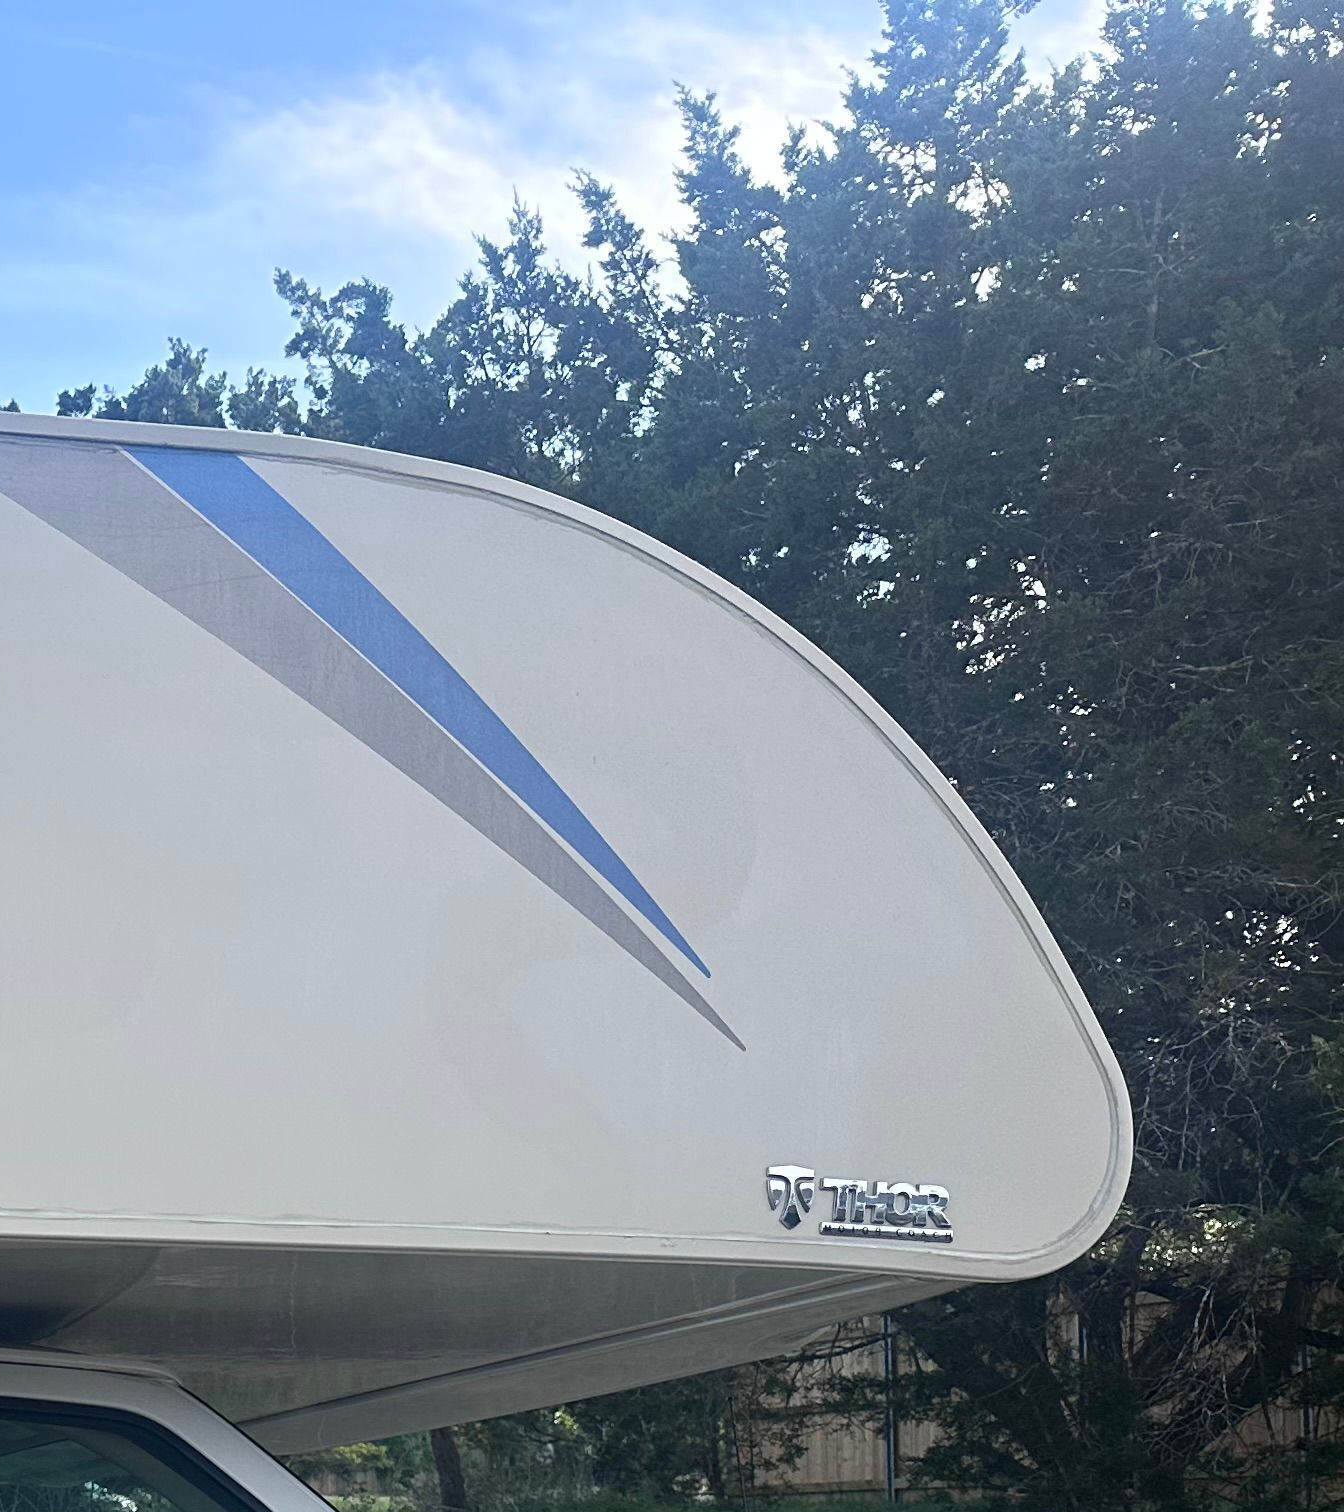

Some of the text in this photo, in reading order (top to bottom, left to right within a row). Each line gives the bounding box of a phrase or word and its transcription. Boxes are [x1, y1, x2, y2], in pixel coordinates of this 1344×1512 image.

[820, 1177, 952, 1228] THOR
[823, 1223, 952, 1240] MOTOR COACH
